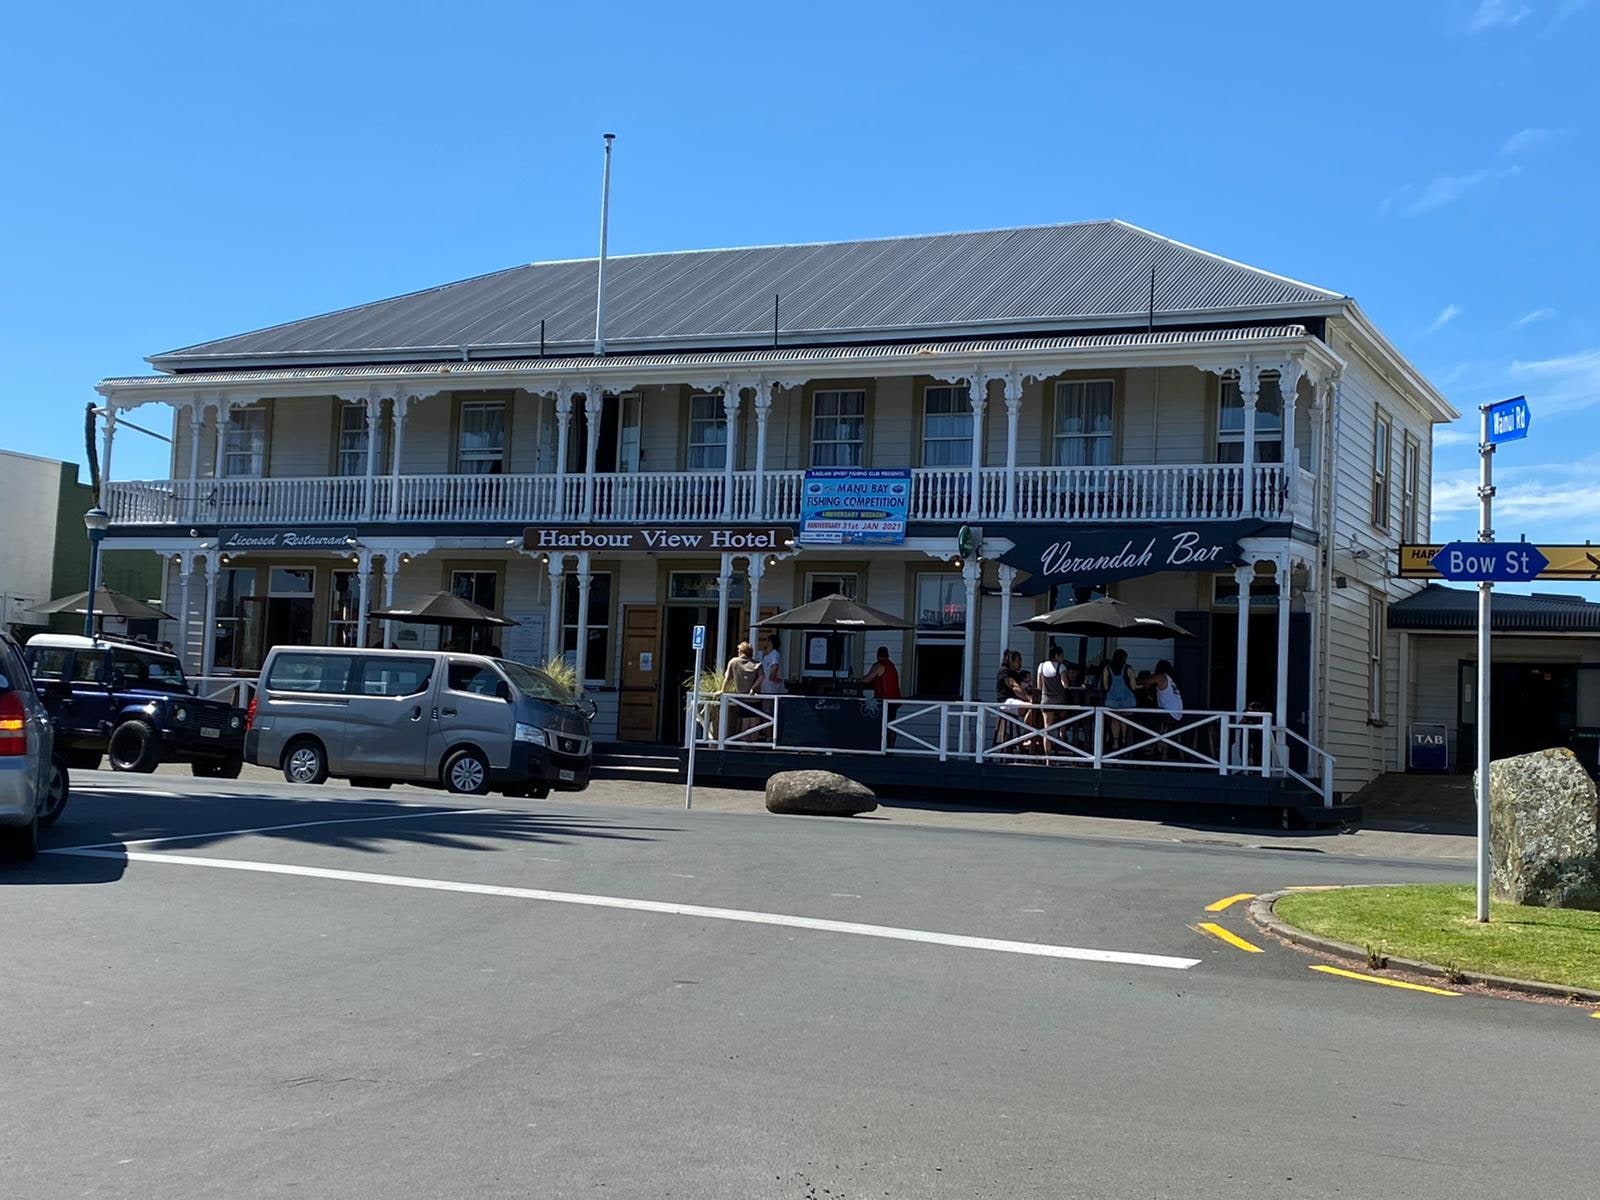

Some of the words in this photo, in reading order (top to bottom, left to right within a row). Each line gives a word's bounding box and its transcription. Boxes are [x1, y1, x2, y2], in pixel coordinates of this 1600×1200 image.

[1493, 408, 1515, 435] Wainui
[1516, 405, 1526, 430] Rd
[837, 483, 868, 494] MANU
[871, 483, 889, 494] BAY
[807, 497, 840, 507] FISHING
[843, 497, 905, 507] COMPETITION
[841, 522, 859, 530] 31st
[862, 522, 879, 530] JAN
[882, 523, 901, 531] 2021
[225, 532, 278, 546] Licensed
[281, 532, 349, 547] Restaurant
[537, 529, 633, 548] Harbour
[640, 529, 703, 548] View
[709, 529, 777, 548] Hotel
[1040, 537, 1157, 576] Verandah
[1165, 531, 1224, 565] Bar
[1450, 550, 1496, 574] Bow
[1505, 550, 1530, 574] St
[1415, 734, 1444, 745] TAB
